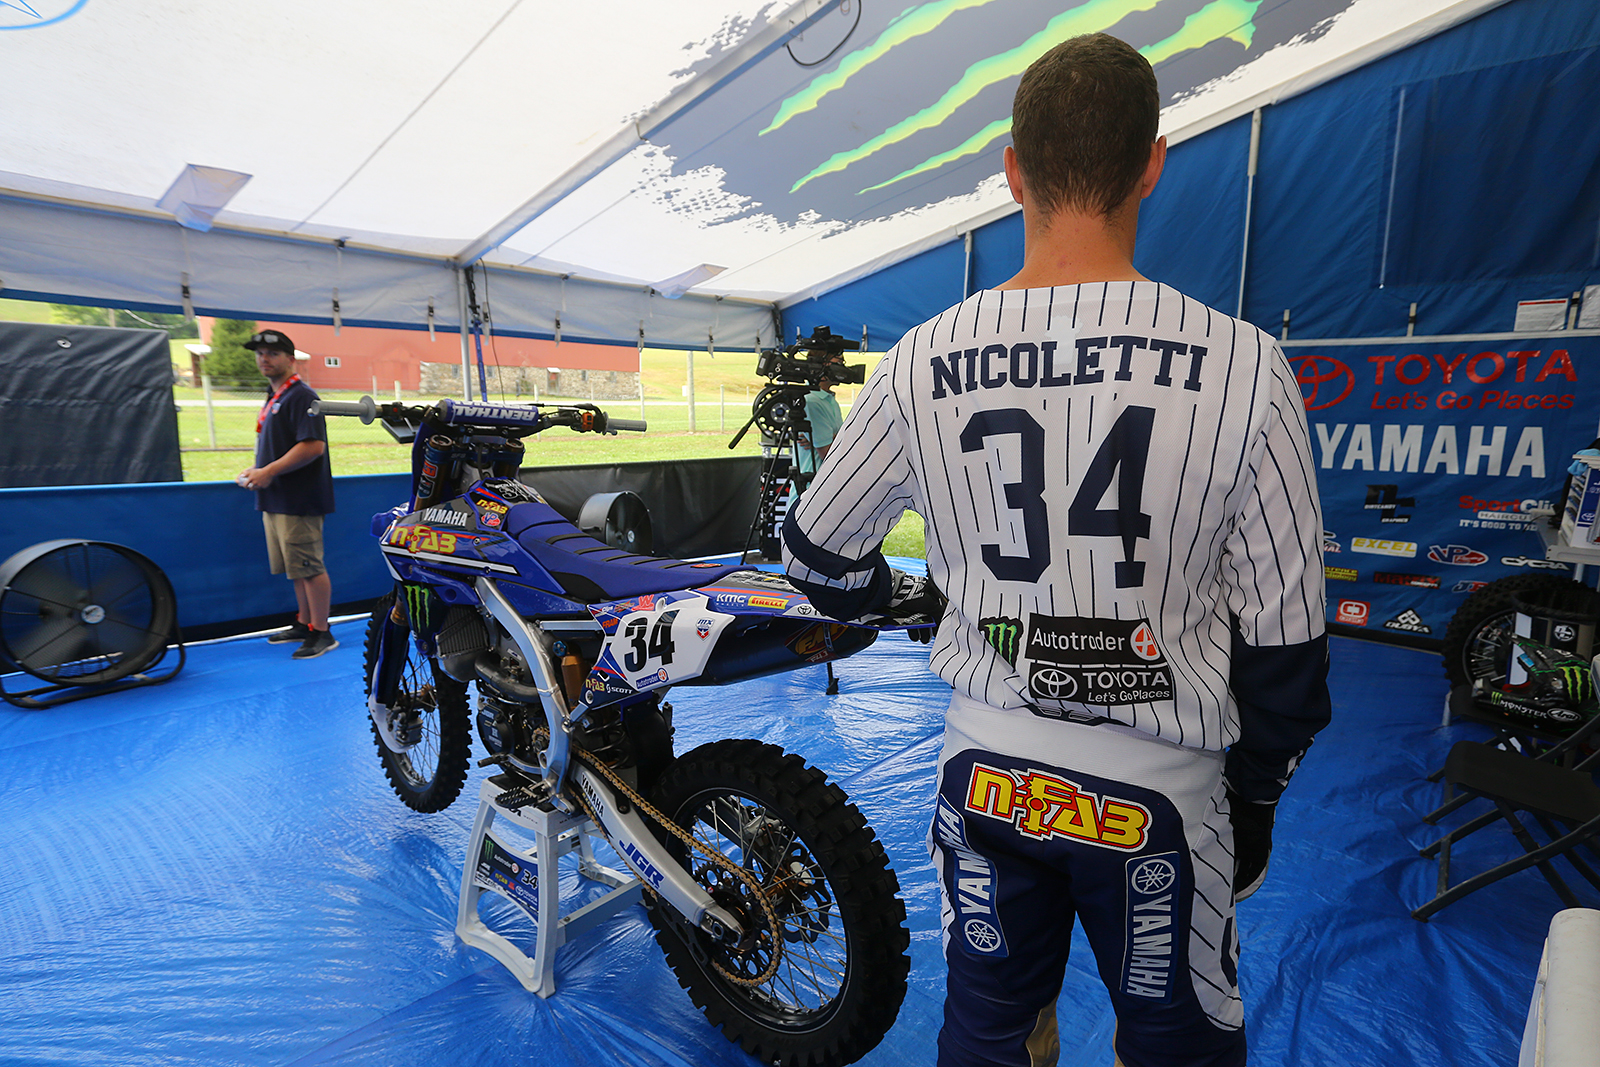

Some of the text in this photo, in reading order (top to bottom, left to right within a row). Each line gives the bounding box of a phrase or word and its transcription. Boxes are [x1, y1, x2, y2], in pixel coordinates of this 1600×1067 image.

[930, 335, 1208, 400] NICOLETTI
[1367, 349, 1578, 385] TOYOTA
[1370, 389, 1576, 410] Let's Go Places
[454, 405, 536, 421] RENTHAL
[1315, 423, 1546, 478] YAMAHA
[959, 404, 1156, 588] 34
[1459, 495, 1555, 513] SportCli
[423, 508, 468, 526] YAMAHA
[1481, 521, 1506, 530] GOOD
[1508, 523, 1522, 531] TO
[1353, 538, 1417, 552] EXCEL
[1501, 556, 1569, 570] CYCRA
[751, 597, 785, 607] PIRELLI
[1385, 621, 1430, 633] DUBYA
[623, 609, 681, 673] 34
[1031, 628, 1126, 651] Autotrader
[1082, 671, 1169, 689] TOYOTA
[611, 686, 633, 694] SCOTT
[1088, 689, 1170, 702] Let's Go Places
[1500, 700, 1547, 718] MONSTER
[582, 773, 604, 817] YAMAHA
[619, 840, 665, 890] JGR
[521, 868, 538, 890] 34
[1127, 893, 1172, 998] YAMAHA
